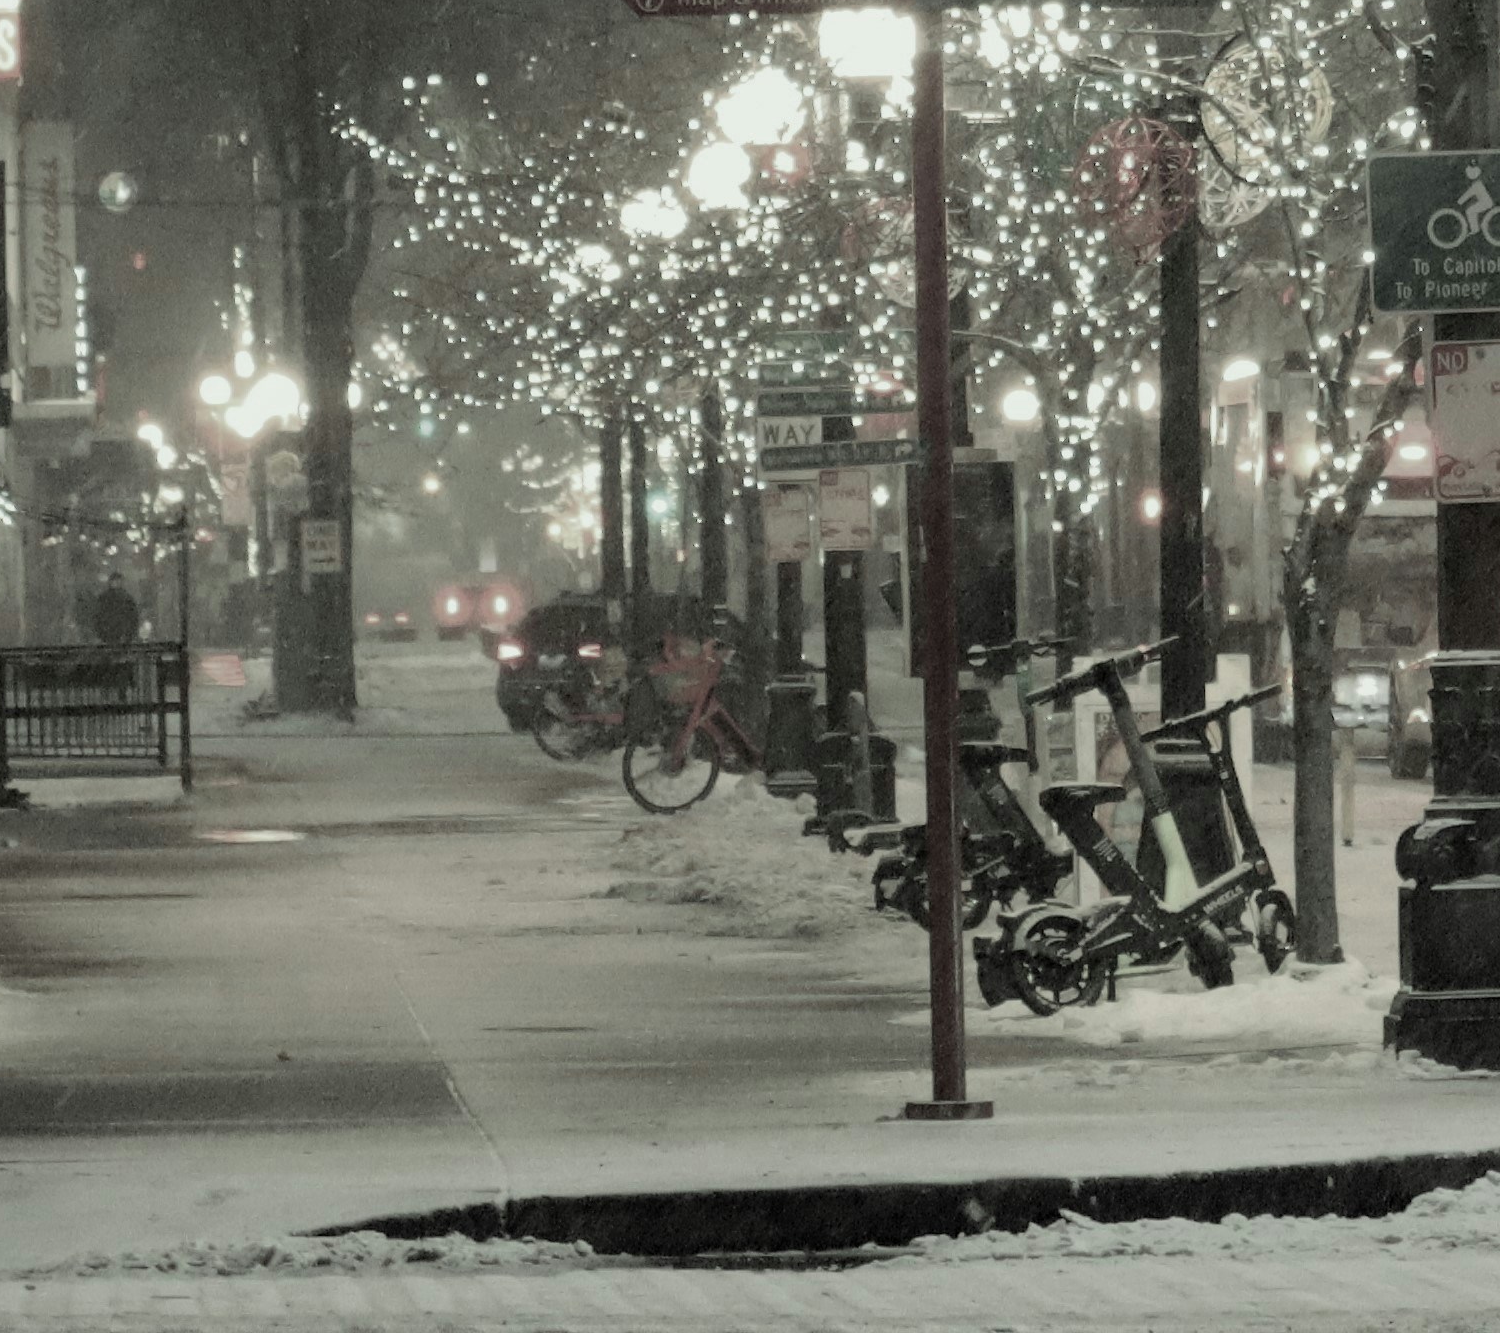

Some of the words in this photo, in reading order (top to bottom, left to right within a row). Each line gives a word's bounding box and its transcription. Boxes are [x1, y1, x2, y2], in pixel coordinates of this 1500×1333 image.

[1413, 257, 1430, 276] To
[1443, 255, 1500, 278] Capitol
[1395, 281, 1412, 300] To
[1424, 280, 1488, 299] Pioneer
[1436, 351, 1465, 371] NO
[763, 422, 815, 445] WAY
